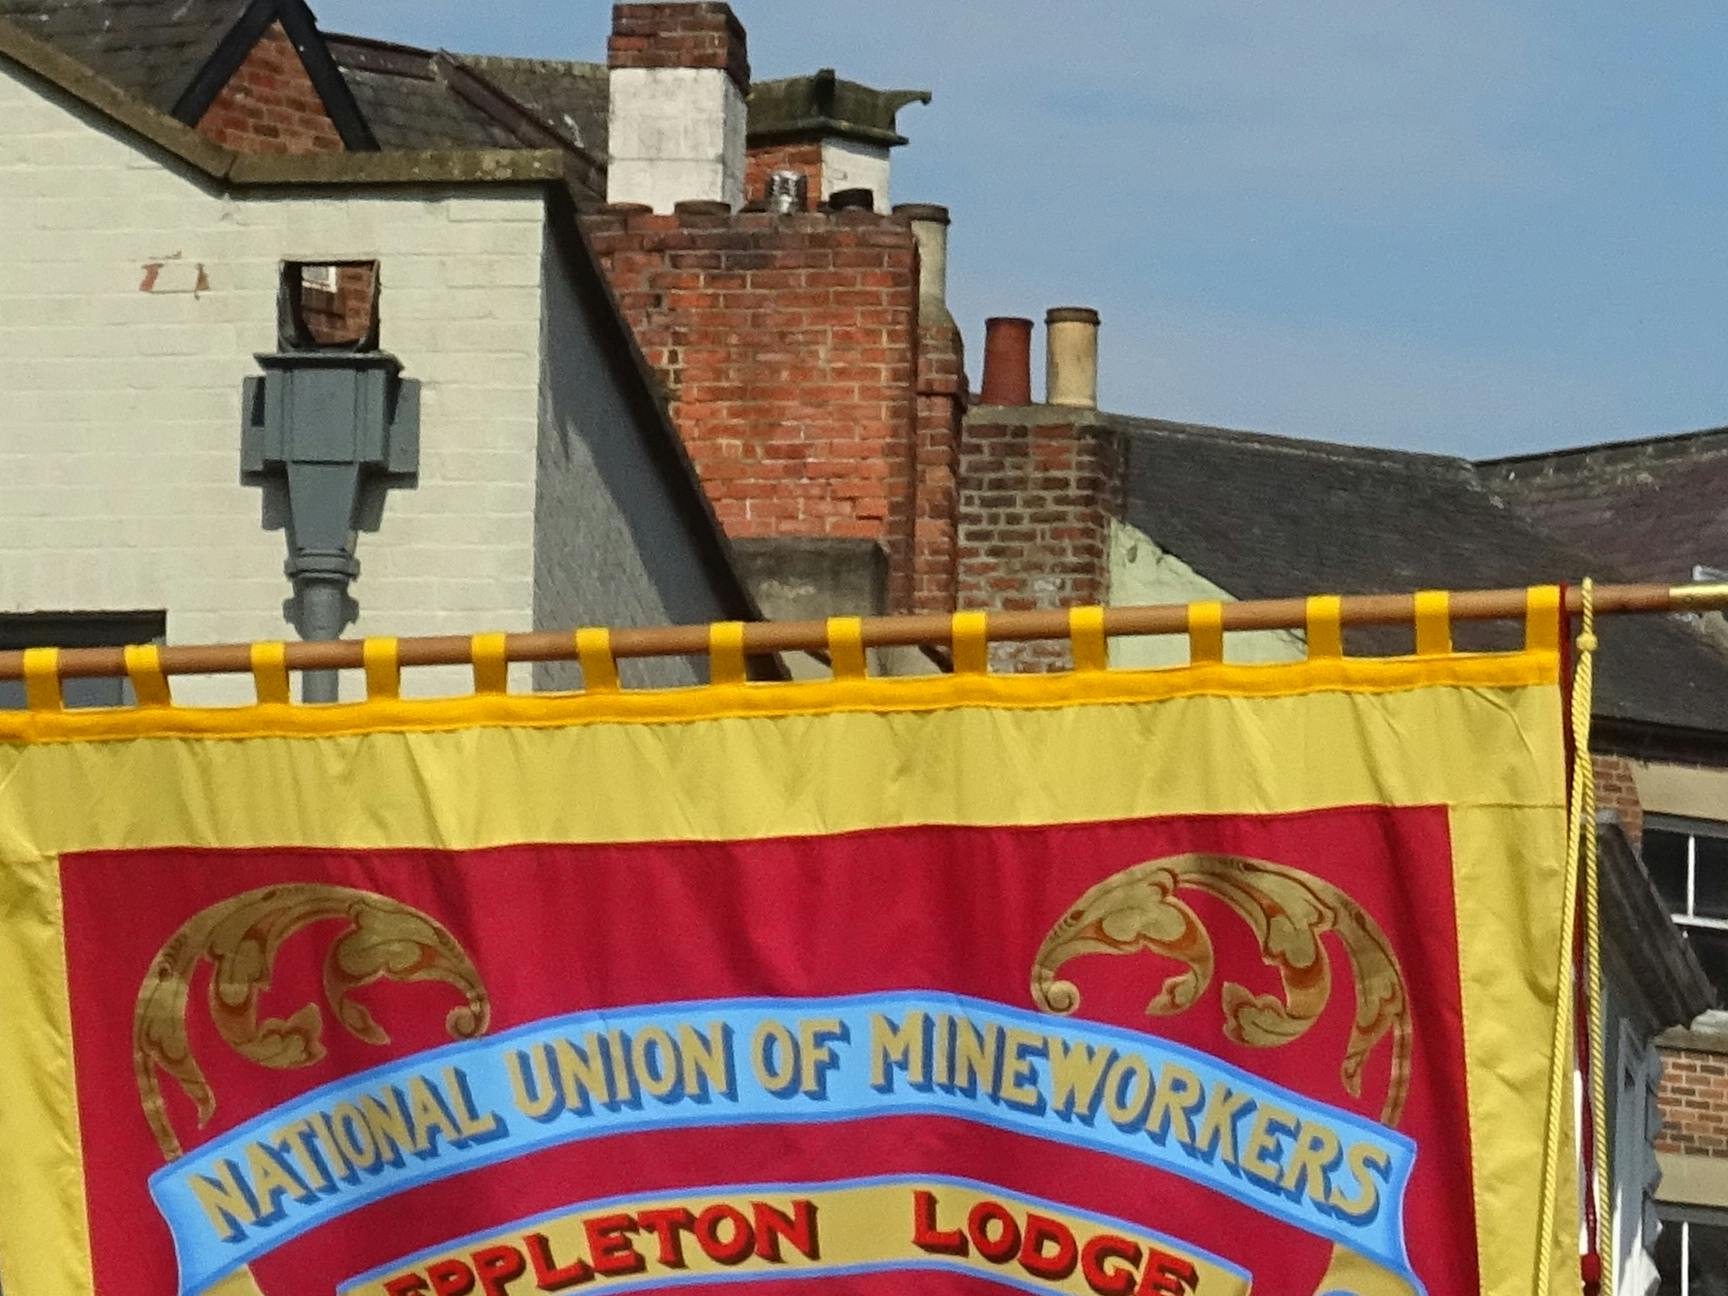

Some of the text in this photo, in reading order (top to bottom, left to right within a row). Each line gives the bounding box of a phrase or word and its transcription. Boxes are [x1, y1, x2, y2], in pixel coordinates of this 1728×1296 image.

[187, 1012, 1391, 1243] NATIONAL UNION OF MINEWORKERS
